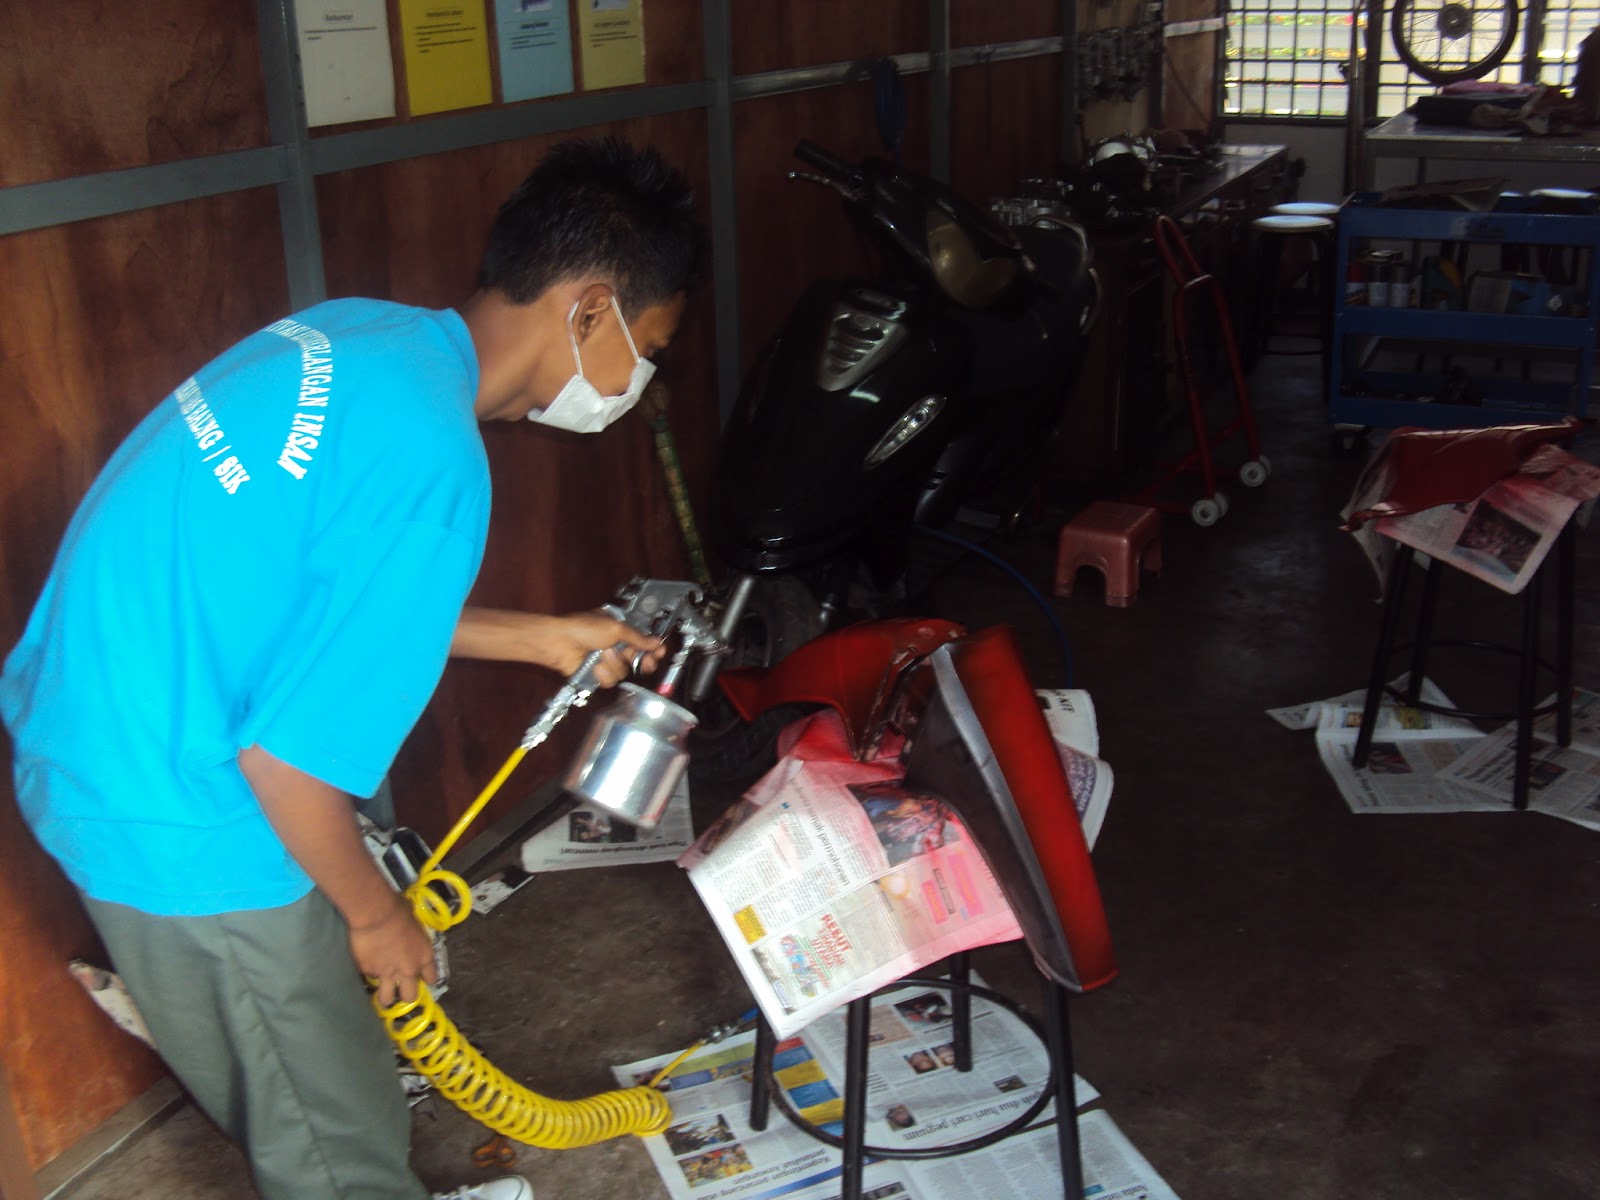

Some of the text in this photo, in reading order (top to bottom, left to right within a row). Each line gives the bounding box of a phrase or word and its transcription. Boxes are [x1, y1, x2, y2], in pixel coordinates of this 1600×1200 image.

[276, 412, 326, 480] INSAN
[213, 455, 251, 495] SIK
[817, 833, 850, 886] permohonan
[821, 913, 853, 952] REBUT
[974, 1106, 1000, 1120] hari
[1000, 1099, 1020, 1112] dua
[903, 1119, 949, 1141] peguam
[951, 1114, 974, 1128] cari
